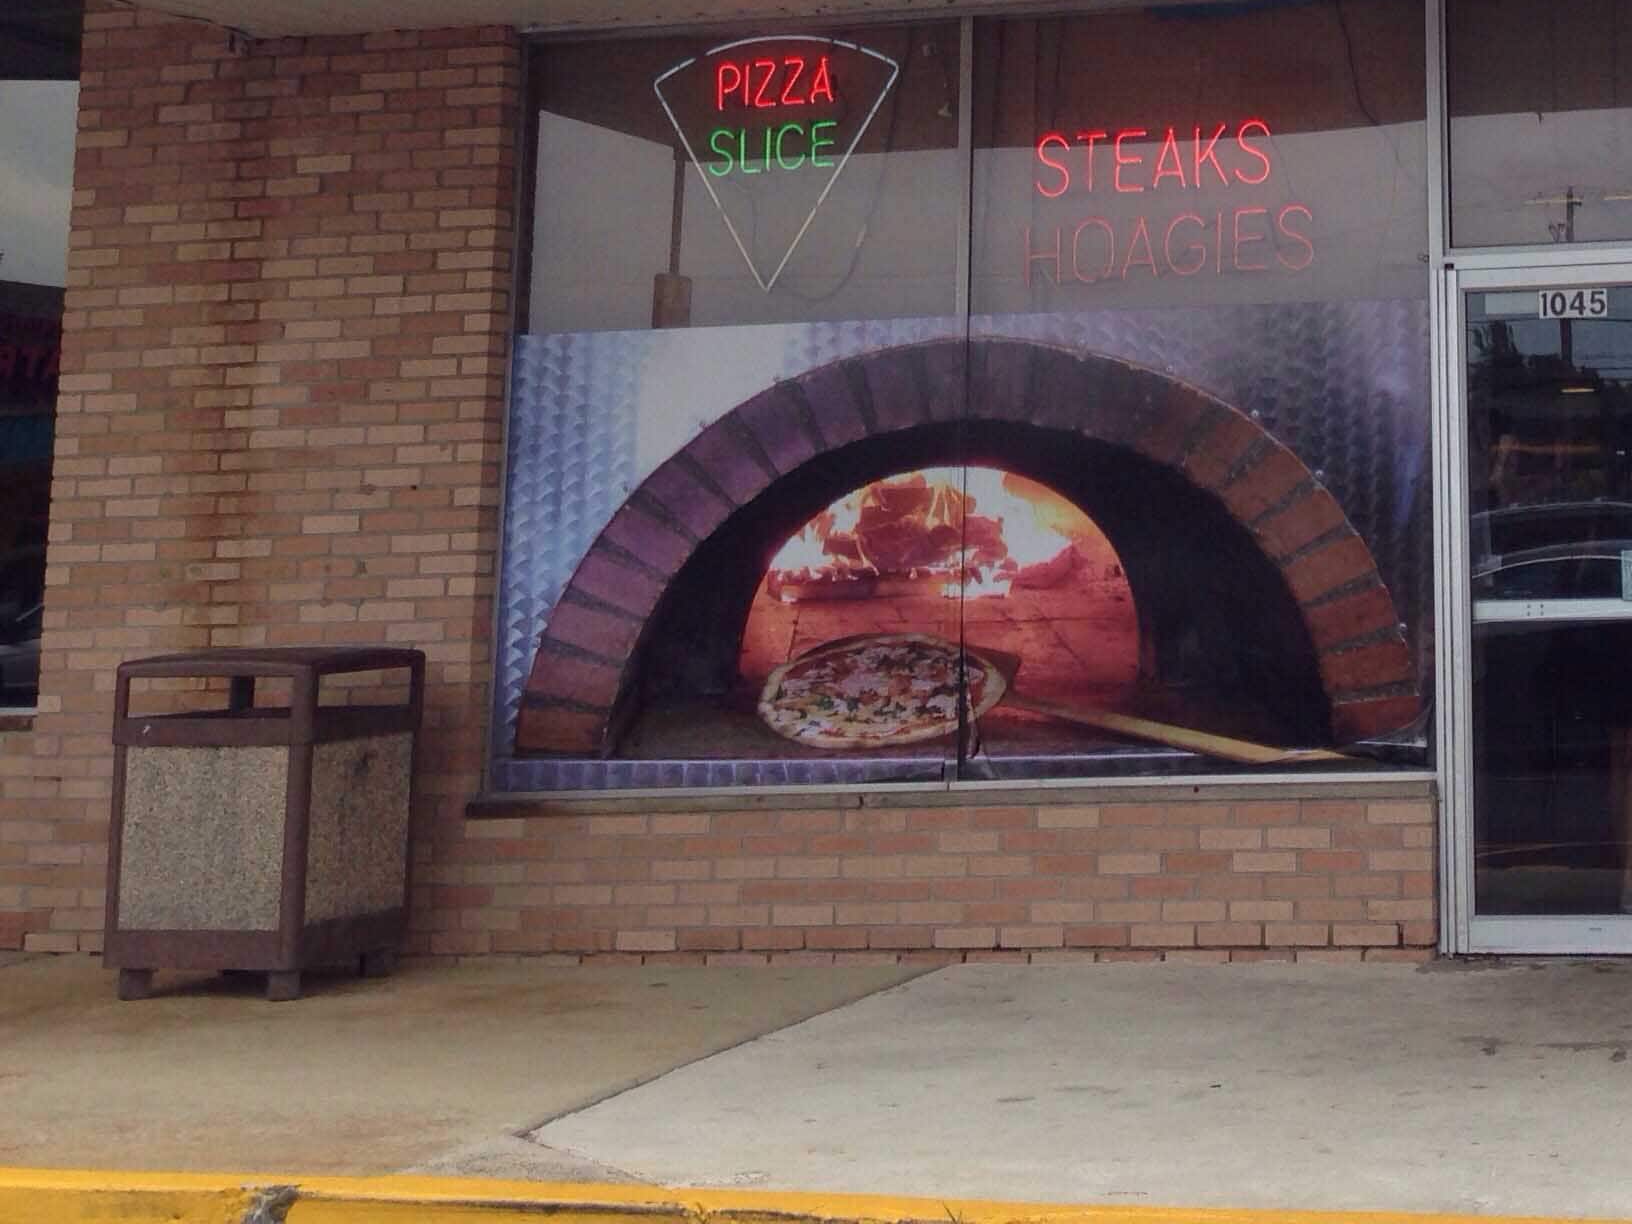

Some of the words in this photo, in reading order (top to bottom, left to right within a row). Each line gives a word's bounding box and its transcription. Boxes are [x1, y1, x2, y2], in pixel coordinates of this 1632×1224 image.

[714, 56, 835, 111] PIZZA
[707, 121, 837, 177] SLICE
[1035, 118, 1272, 198] STEAKS
[1023, 204, 1315, 289] HOAGIES
[1540, 289, 1606, 317] 1045
